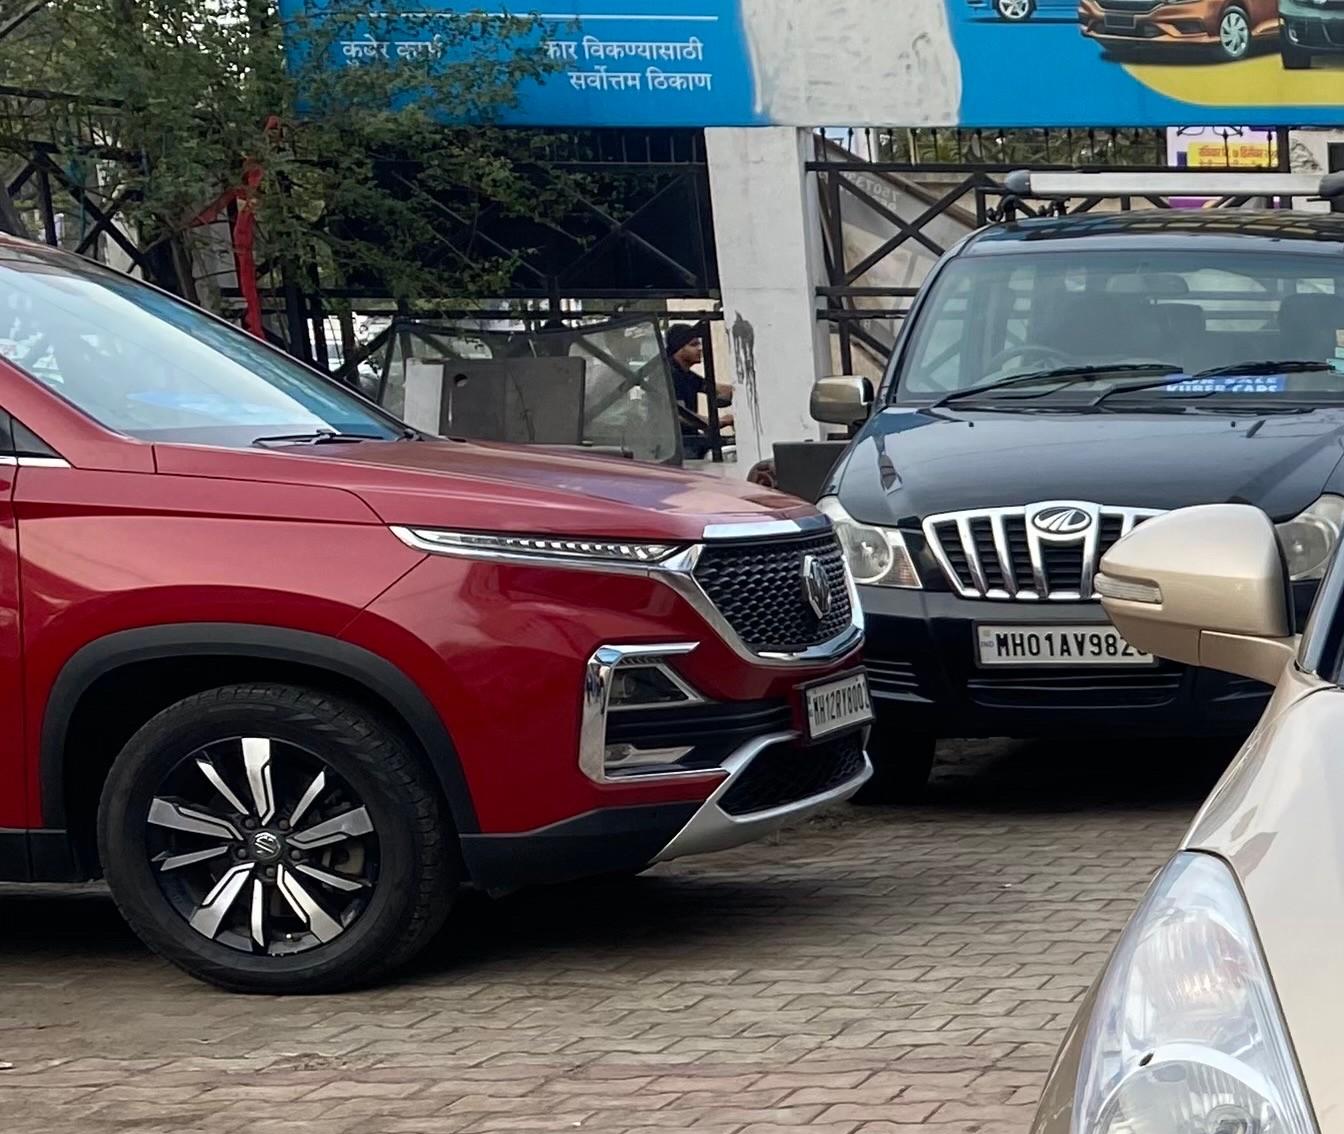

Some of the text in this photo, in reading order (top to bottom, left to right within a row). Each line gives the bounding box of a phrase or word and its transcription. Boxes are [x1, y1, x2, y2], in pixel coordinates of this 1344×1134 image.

[582, 35, 703, 60] विकण्यासाठी
[568, 65, 712, 91] सर्वोत्तम ठिकाण
[996, 633, 1148, 656] MH01AV982
